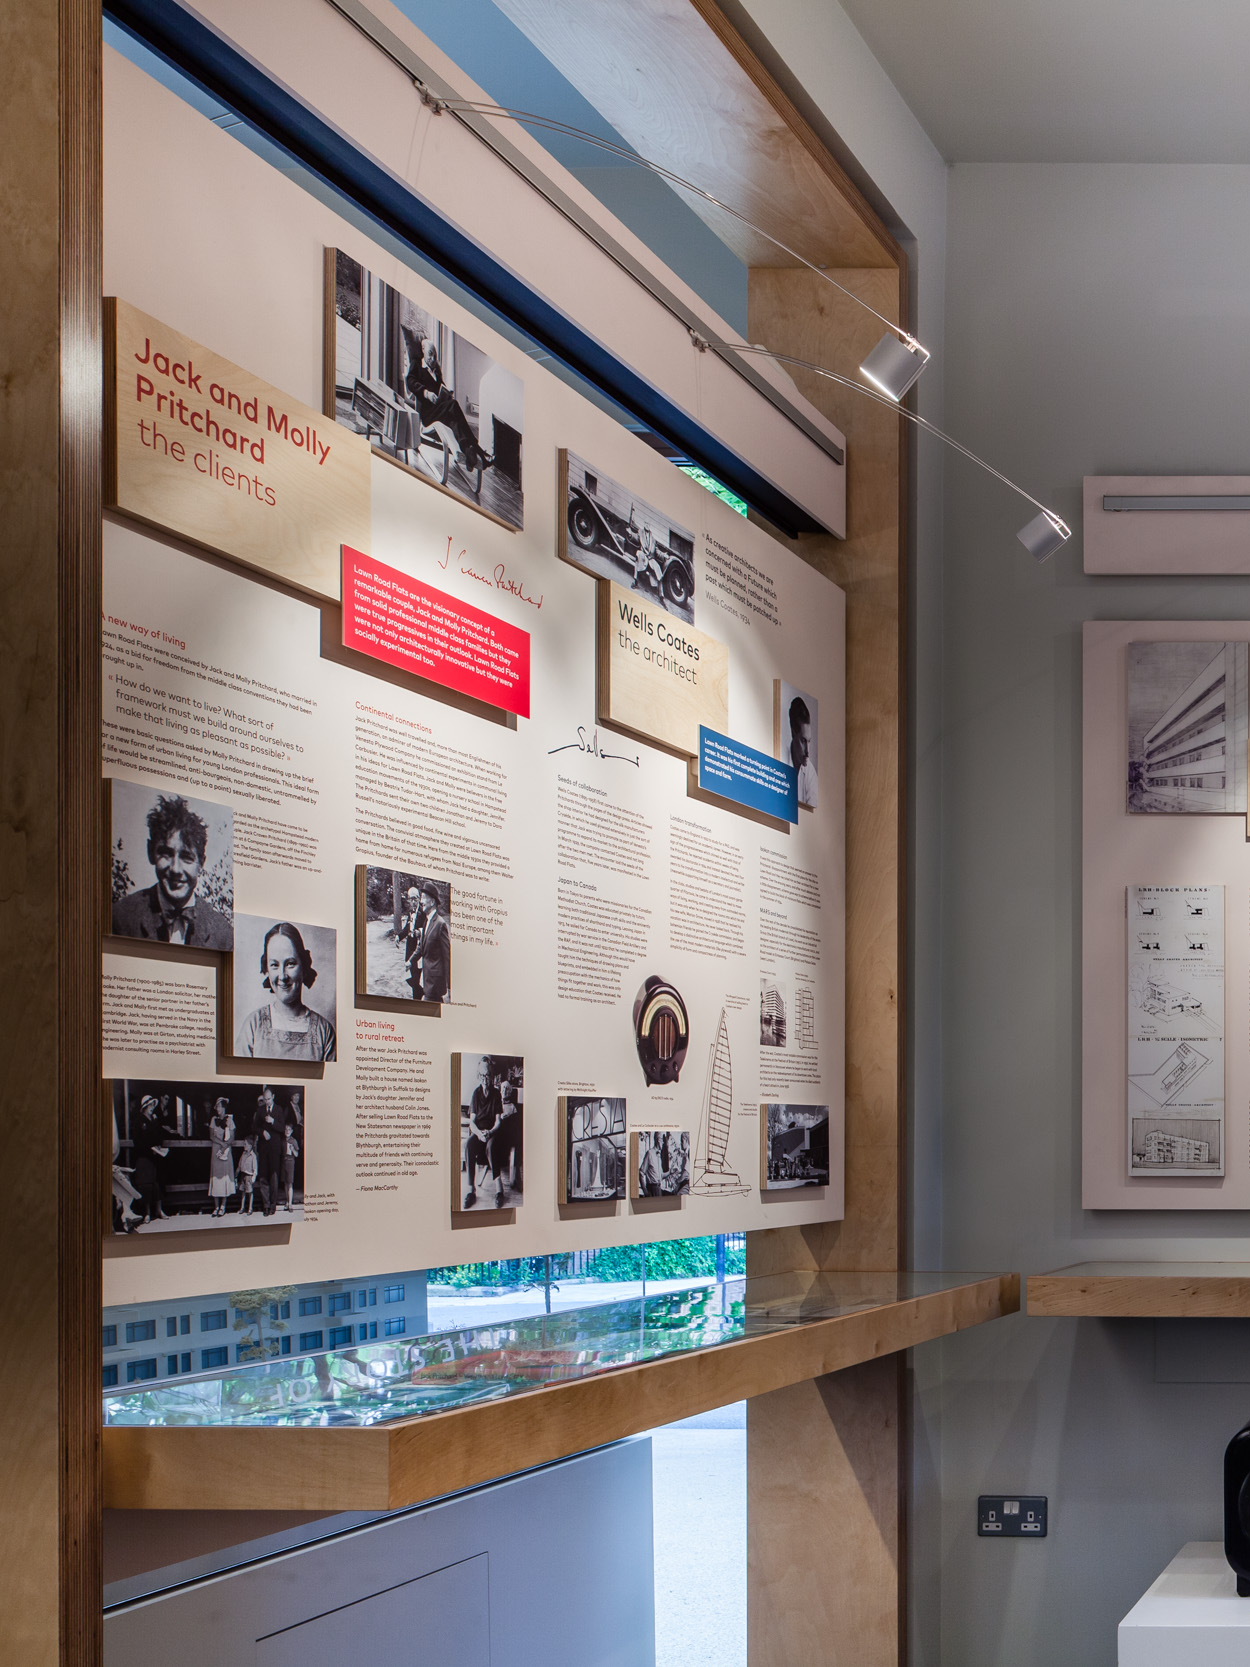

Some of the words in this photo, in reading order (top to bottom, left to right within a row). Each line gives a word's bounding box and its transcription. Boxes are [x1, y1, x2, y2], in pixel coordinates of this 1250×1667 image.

[134, 337, 202, 394] Jack
[209, 383, 258, 424] and
[267, 405, 331, 465] Molly
[136, 373, 265, 465] Pritchard
[137, 418, 185, 462] the
[194, 449, 276, 506] clients
[705, 533, 713, 545] As
[713, 540, 734, 559] creative
[734, 554, 758, 576] architects
[758, 571, 766, 581] we
[765, 576, 774, 586] are
[705, 548, 732, 570] concerned
[732, 565, 743, 577] with
[743, 573, 748, 581] a
[747, 574, 764, 592] Future
[764, 587, 777, 600] which
[354, 564, 373, 580] Lawn
[373, 573, 391, 589] Road
[392, 582, 409, 597] Flats
[409, 592, 421, 602] are
[421, 596, 432, 608] the
[432, 602, 460, 621] visionary
[460, 616, 484, 632] concept
[483, 626, 491, 635] of
[354, 579, 392, 601] remarkable
[392, 597, 416, 613] couple,
[416, 606, 431, 619] Jack
[431, 614, 444, 624] and
[444, 618, 461, 633] Molly
[461, 626, 490, 646] Pritchard.
[490, 639, 504, 652] Both
[504, 647, 519, 659] came
[706, 591, 720, 606] Wells
[720, 600, 740, 618] Coates,
[739, 613, 751, 626] 1934
[108, 615, 128, 628] new
[129, 623, 149, 636] way
[150, 630, 161, 640] of
[162, 632, 186, 650] living
[354, 590, 371, 604] from
[372, 599, 388, 611] solid
[388, 606, 428, 629] professional
[428, 624, 449, 638] middle
[449, 633, 465, 645] class
[465, 638, 488, 656] families
[488, 649, 498, 660] but
[498, 655, 511, 666] they
[618, 600, 654, 636] Wells
[657, 623, 700, 661] Coates
[618, 629, 640, 655] the
[643, 646, 697, 685] architect
[116, 674, 138, 689] How
[139, 682, 152, 693] do
[152, 688, 167, 698] we
[168, 693, 191, 706] want
[192, 699, 203, 709] to
[204, 701, 222, 715] live?
[222, 707, 246, 723] What
[248, 717, 264, 729] sort
[265, 722, 275, 731] of
[116, 688, 167, 712] framework
[168, 707, 192, 720] must
[192, 714, 206, 724] we
[207, 716, 228, 730] build
[229, 725, 258, 740] around
[259, 734, 295, 750] ourselves
[295, 744, 305, 753] to
[355, 701, 394, 721] Continental
[395, 716, 432, 734] connections
[116, 705, 142, 719] make
[143, 712, 164, 726] that
[165, 717, 188, 735] living
[189, 727, 201, 736] as
[202, 730, 238, 747] pleasant
[239, 741, 250, 751] as
[250, 745, 286, 760] possible?
[558, 774, 572, 785] Seeds
[578, 783, 608, 797] collaboration
[355, 1019, 377, 1029] Urban
[378, 1021, 395, 1032] living
[355, 1032, 364, 1040] to
[364, 1033, 381, 1041] rural
[381, 1034, 405, 1043] retreat
